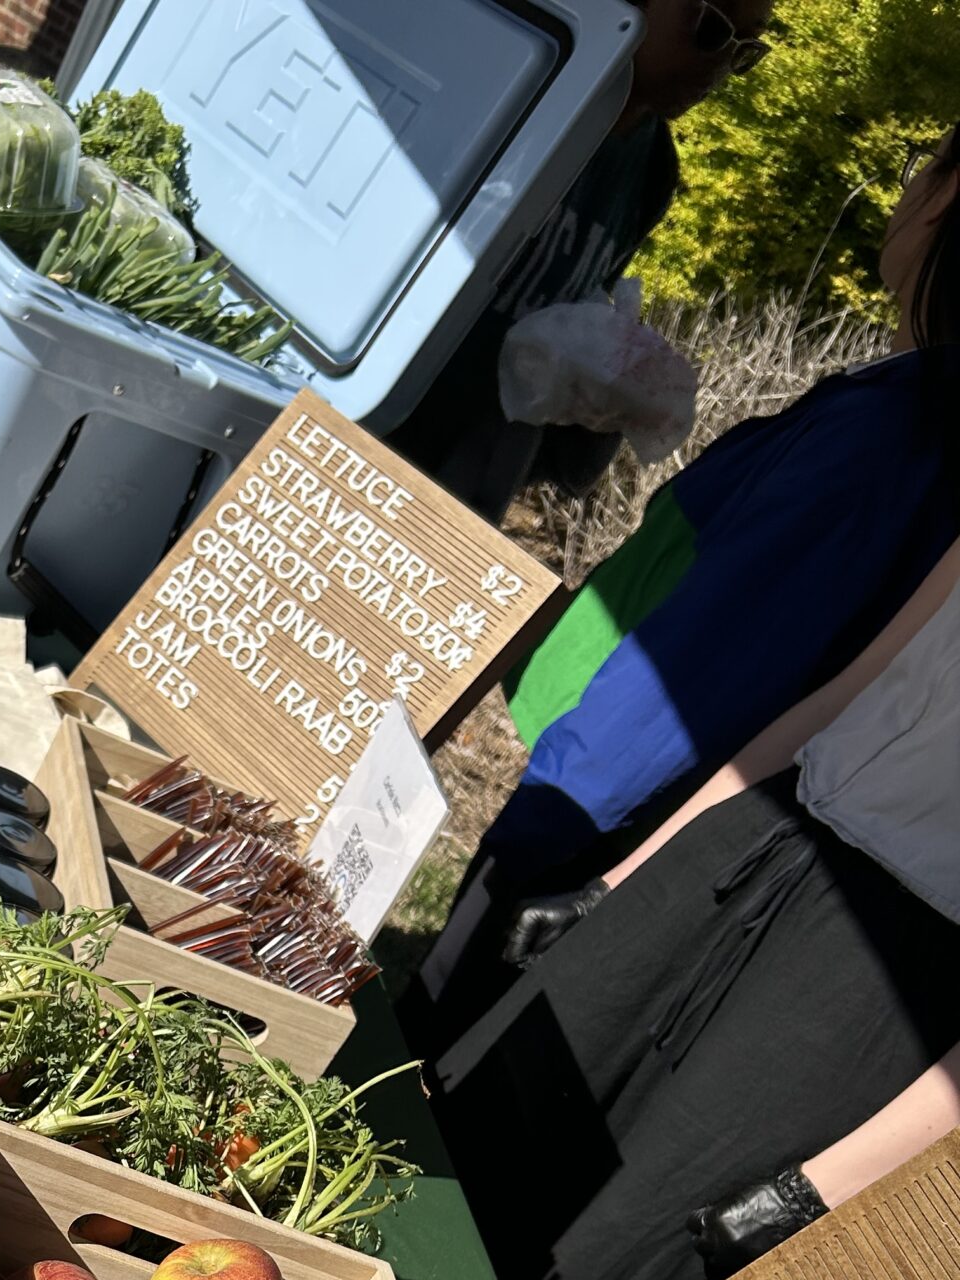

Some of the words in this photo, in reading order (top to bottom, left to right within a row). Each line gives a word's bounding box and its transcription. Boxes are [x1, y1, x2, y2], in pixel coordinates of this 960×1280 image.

[188, 0, 422, 221] YETI
[192, 528, 280, 611] GREEN
[238, 476, 337, 558] SWEET
[325, 547, 429, 637] POTATO
[261, 447, 449, 597] STRAWBERRY
[448, 601, 489, 641] $4
[286, 413, 415, 521] LETTUCE
[480, 564, 523, 606] $2
[115, 626, 200, 710] TOTES
[135, 608, 202, 668] JAM
[154, 576, 283, 694] BROCCOLI
[274, 679, 354, 756] RAAB
[170, 556, 275, 650] APPLES
[215, 502, 330, 602] CARROTS
[384, 651, 425, 700] $2
